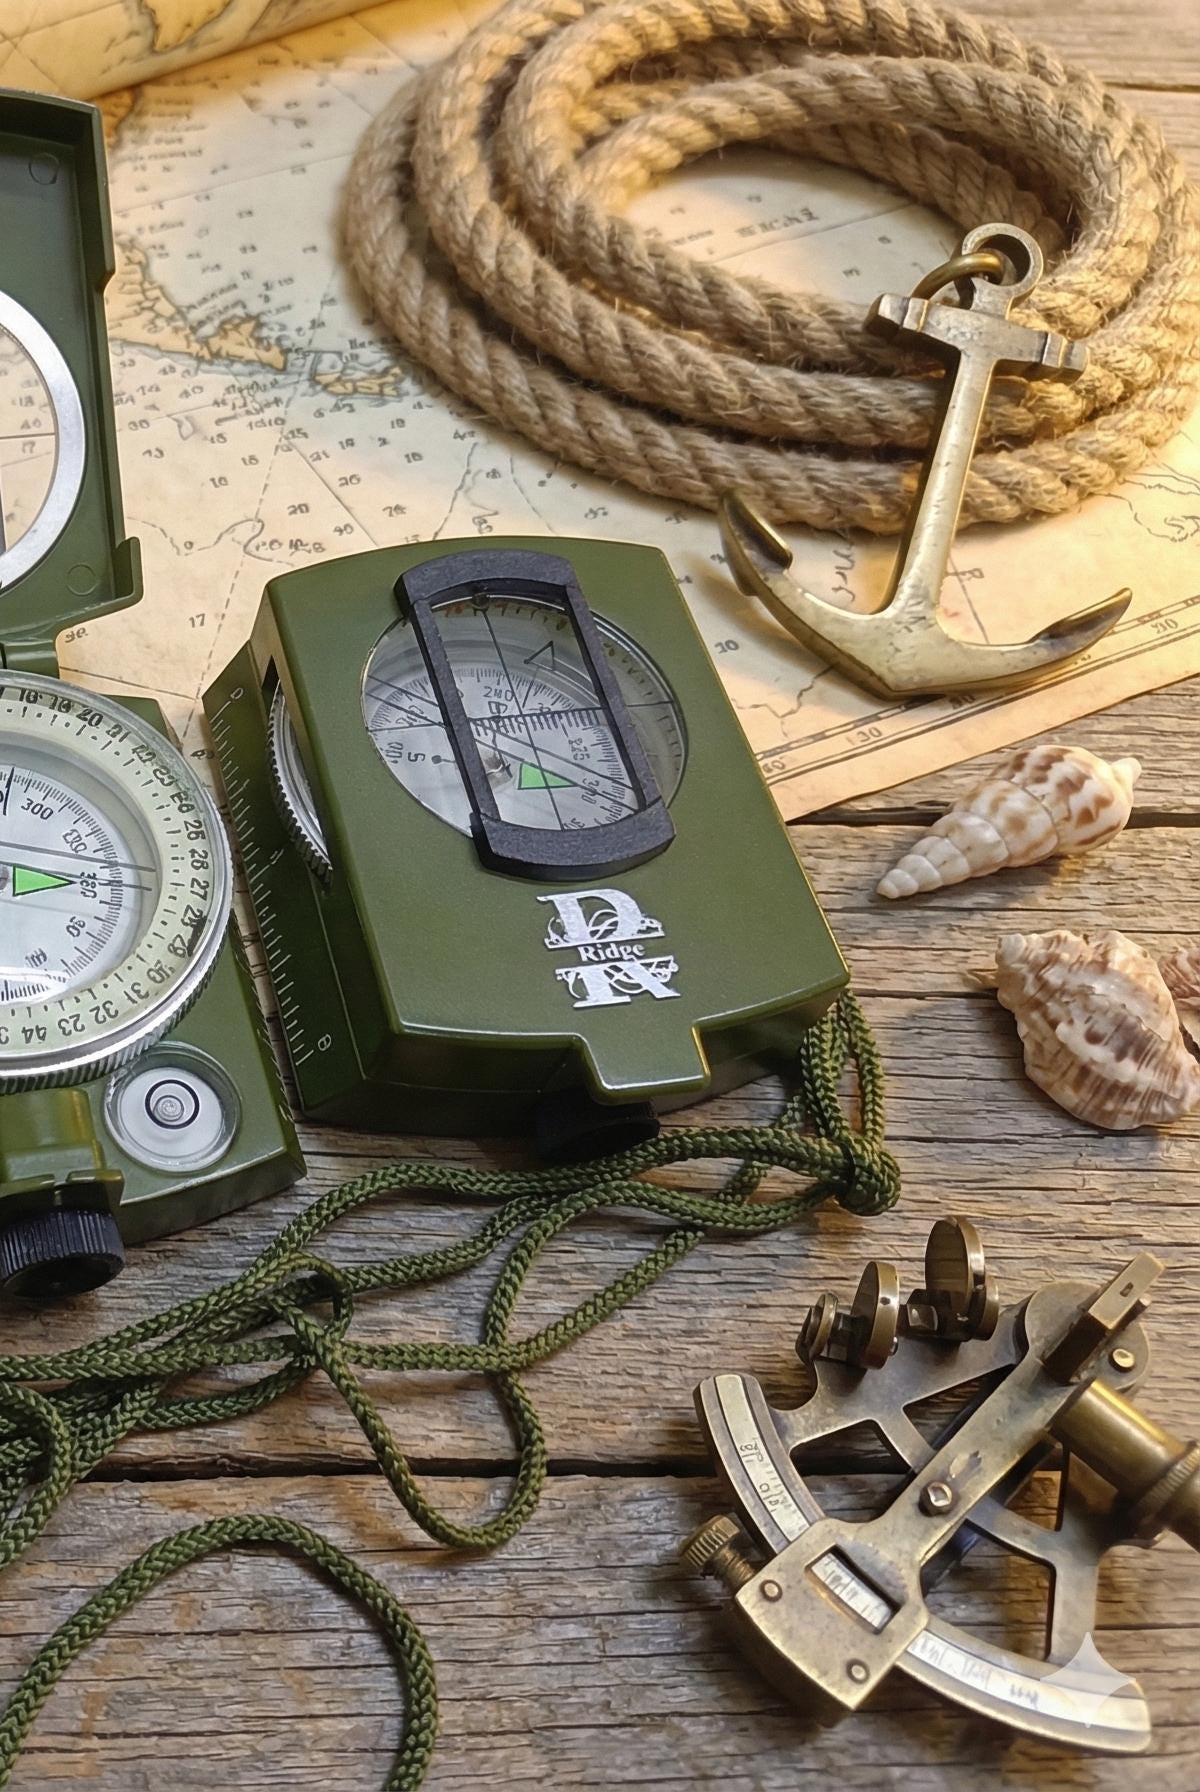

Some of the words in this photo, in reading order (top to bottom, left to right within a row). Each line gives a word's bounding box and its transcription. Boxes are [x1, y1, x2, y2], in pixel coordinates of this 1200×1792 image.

[188, 612, 207, 629] 17
[75, 706, 105, 729] 20
[20, 797, 54, 821] 300
[190, 876, 211, 902] 27
[578, 943, 646, 961] Ridge
[88, 999, 120, 1025] 32
